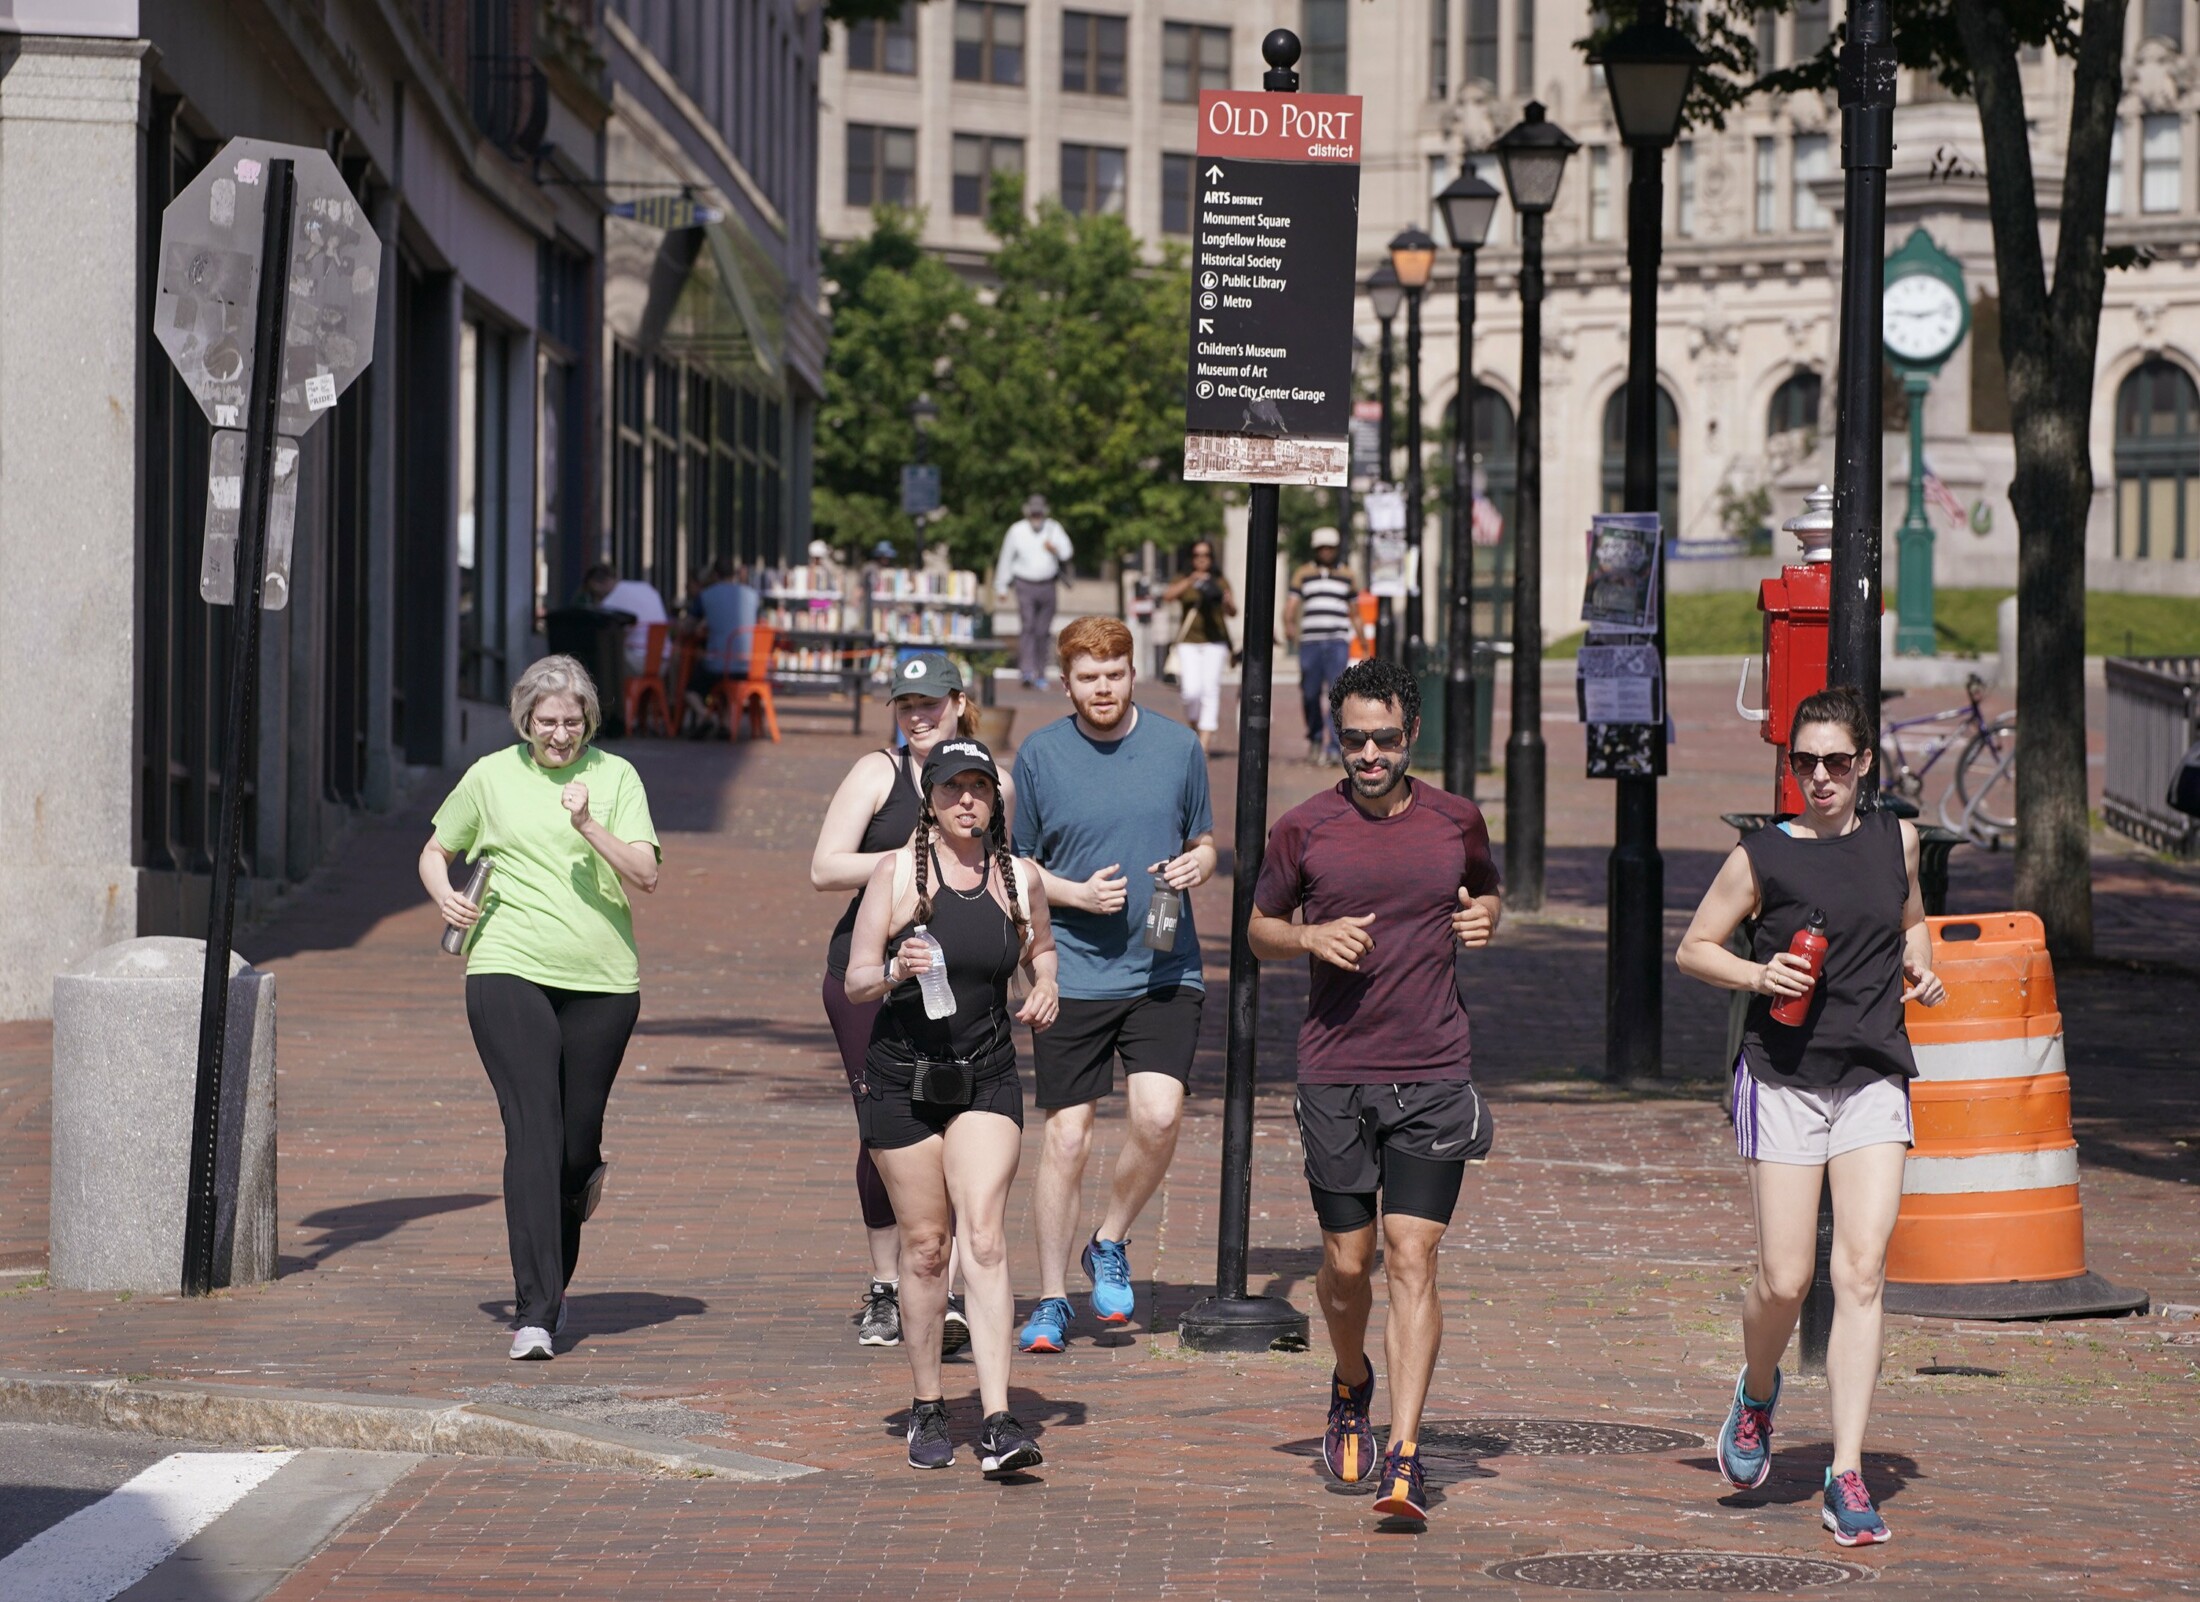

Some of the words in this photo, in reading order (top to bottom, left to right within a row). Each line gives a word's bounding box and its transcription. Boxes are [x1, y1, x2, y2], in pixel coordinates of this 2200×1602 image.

[1209, 101, 1268, 136] OLD
[1280, 104, 1354, 140] PORT
[1308, 143, 1353, 158] district
[1204, 191, 1230, 204] ARTS
[1231, 196, 1263, 206] DISTRICT
[1203, 211, 1255, 226] Monument
[1257, 214, 1291, 230] Square
[1202, 232, 1255, 248] Longfellow
[1257, 234, 1286, 248] House
[1201, 252, 1245, 266] Historical
[1247, 254, 1281, 271] Society
[1222, 274, 1251, 288] Public
[1253, 275, 1286, 292] Library
[1223, 295, 1252, 308] Metro
[1245, 344, 1286, 358] Museum
[1197, 363, 1238, 376] Museum
[1240, 364, 1251, 377] of
[1252, 365, 1268, 378] Art
[1218, 384, 1237, 397] One
[1239, 385, 1257, 400] City
[1259, 386, 1290, 399] Center
[1291, 387, 1325, 404] Garage
